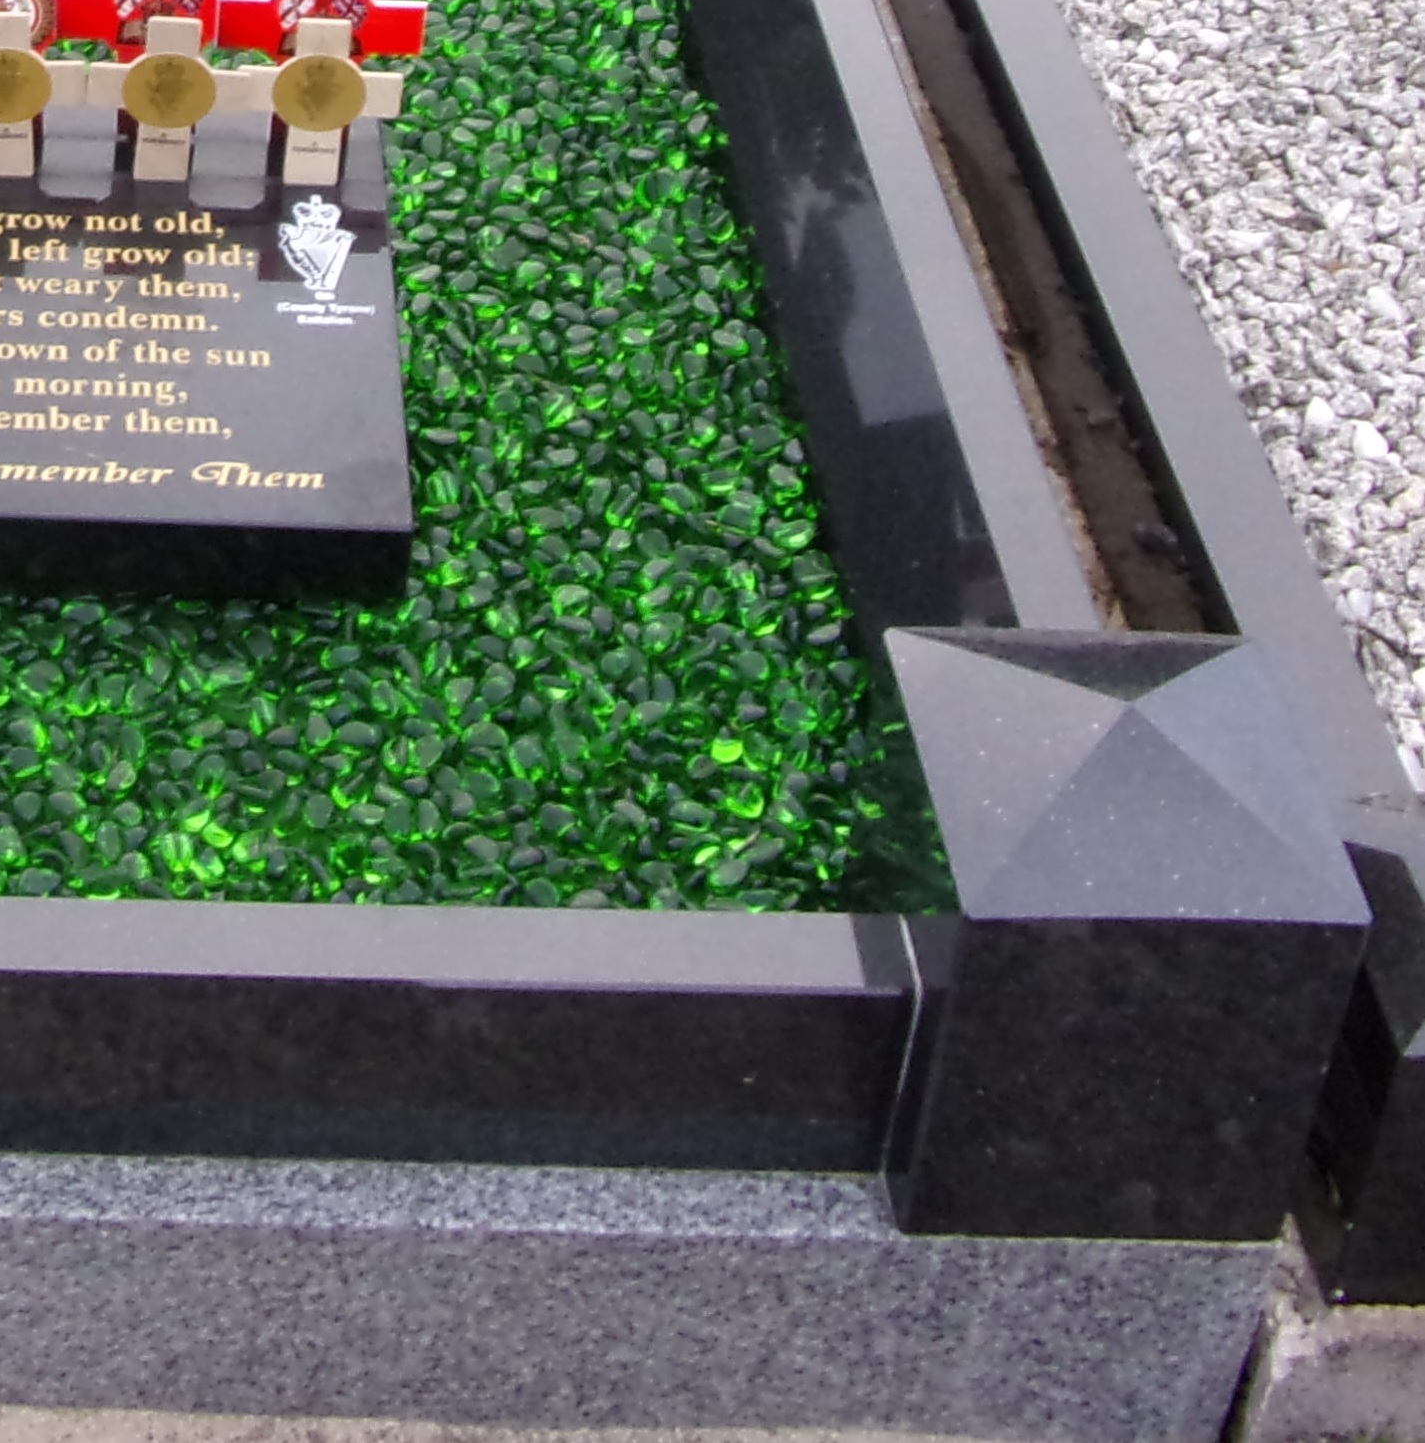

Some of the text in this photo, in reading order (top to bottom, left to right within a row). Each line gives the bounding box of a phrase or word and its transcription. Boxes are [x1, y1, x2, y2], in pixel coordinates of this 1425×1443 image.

[85, 214, 142, 232] not
[155, 212, 224, 238] old,
[9, 239, 68, 260] left
[83, 245, 170, 270] grow
[16, 278, 123, 303] weary
[139, 275, 241, 303] them,
[38, 307, 219, 331] condemn.
[83, 339, 122, 362] of
[133, 340, 190, 364] the
[207, 350, 270, 366] sun
[14, 373, 187, 406] morning,
[125, 408, 231, 439] them,
[192, 462, 325, 489] Them
